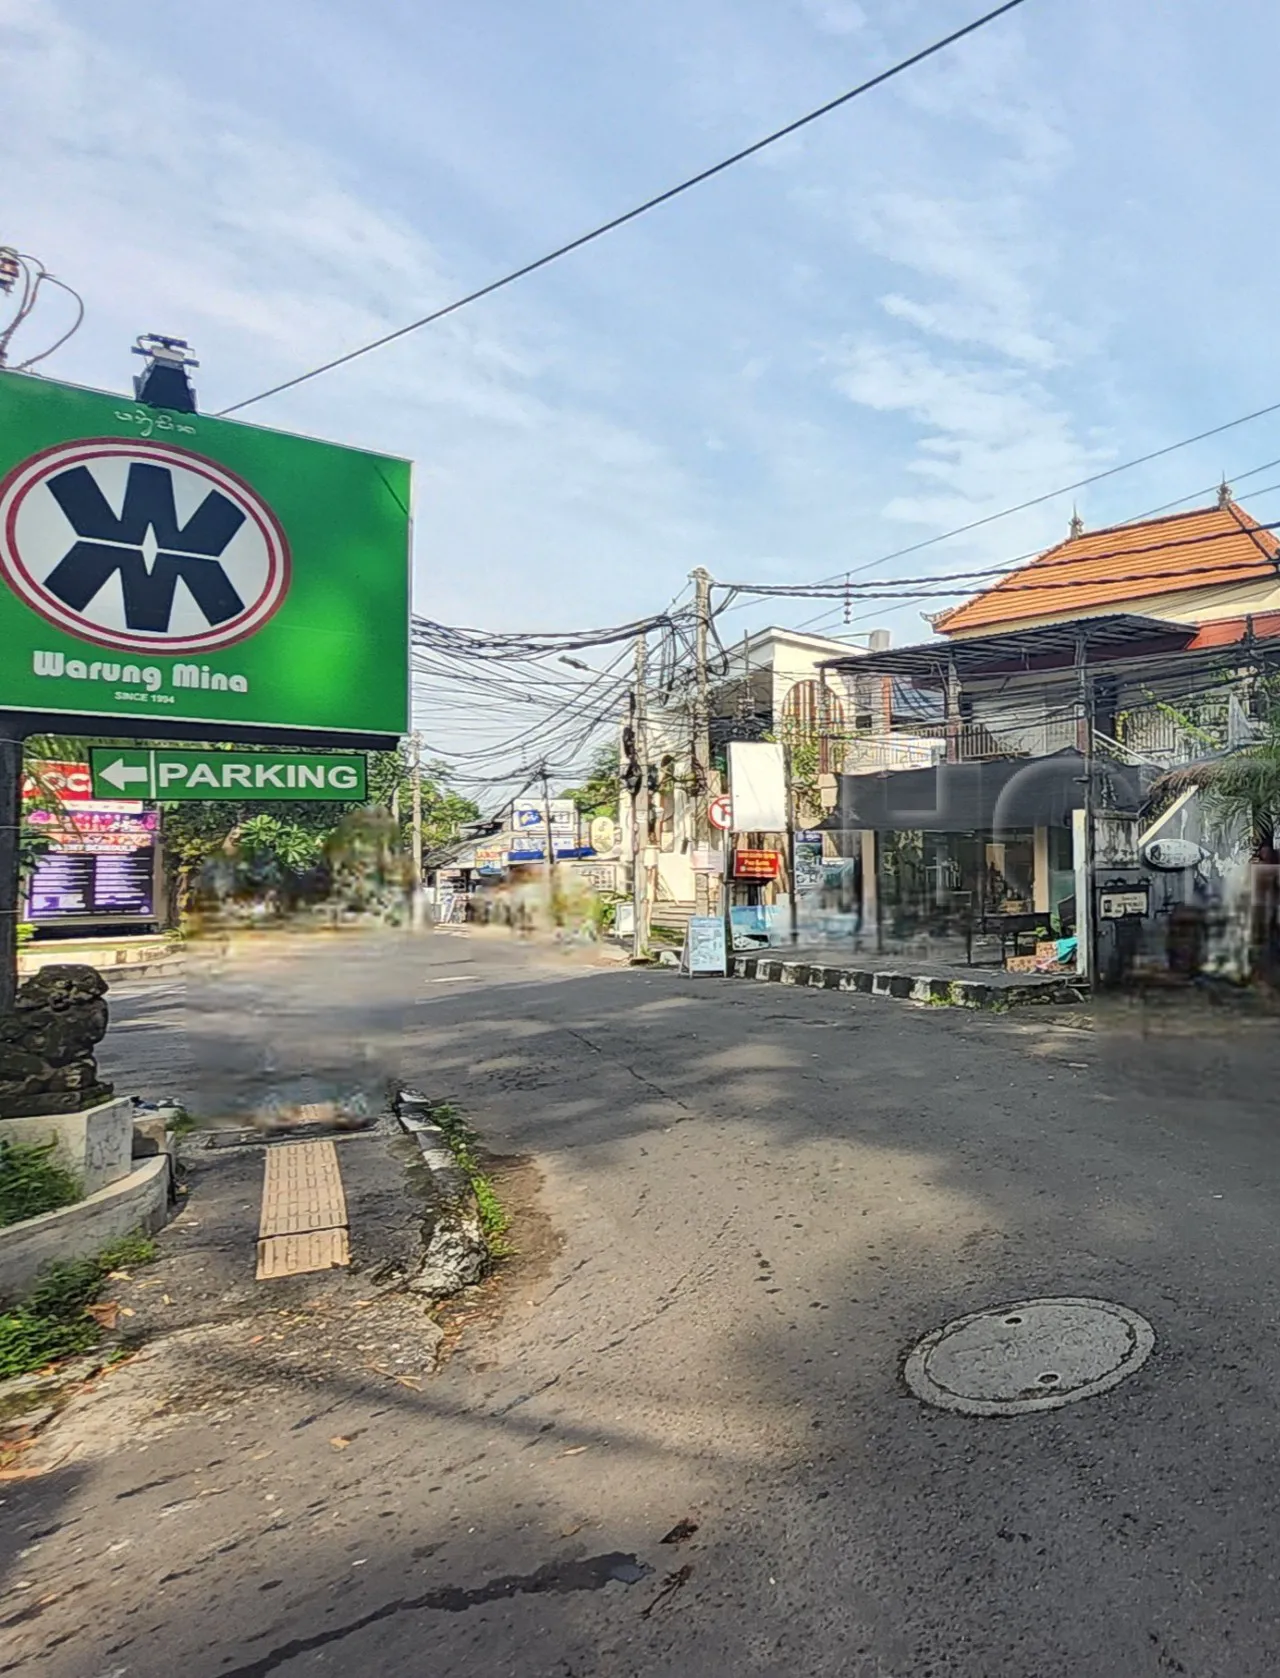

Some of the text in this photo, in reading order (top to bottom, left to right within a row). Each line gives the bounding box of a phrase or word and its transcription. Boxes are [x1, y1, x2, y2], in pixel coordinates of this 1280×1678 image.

[33, 650, 248, 693] Warung Mina
[114, 691, 175, 704] SINCE 1994
[158, 762, 359, 789] PARKING
